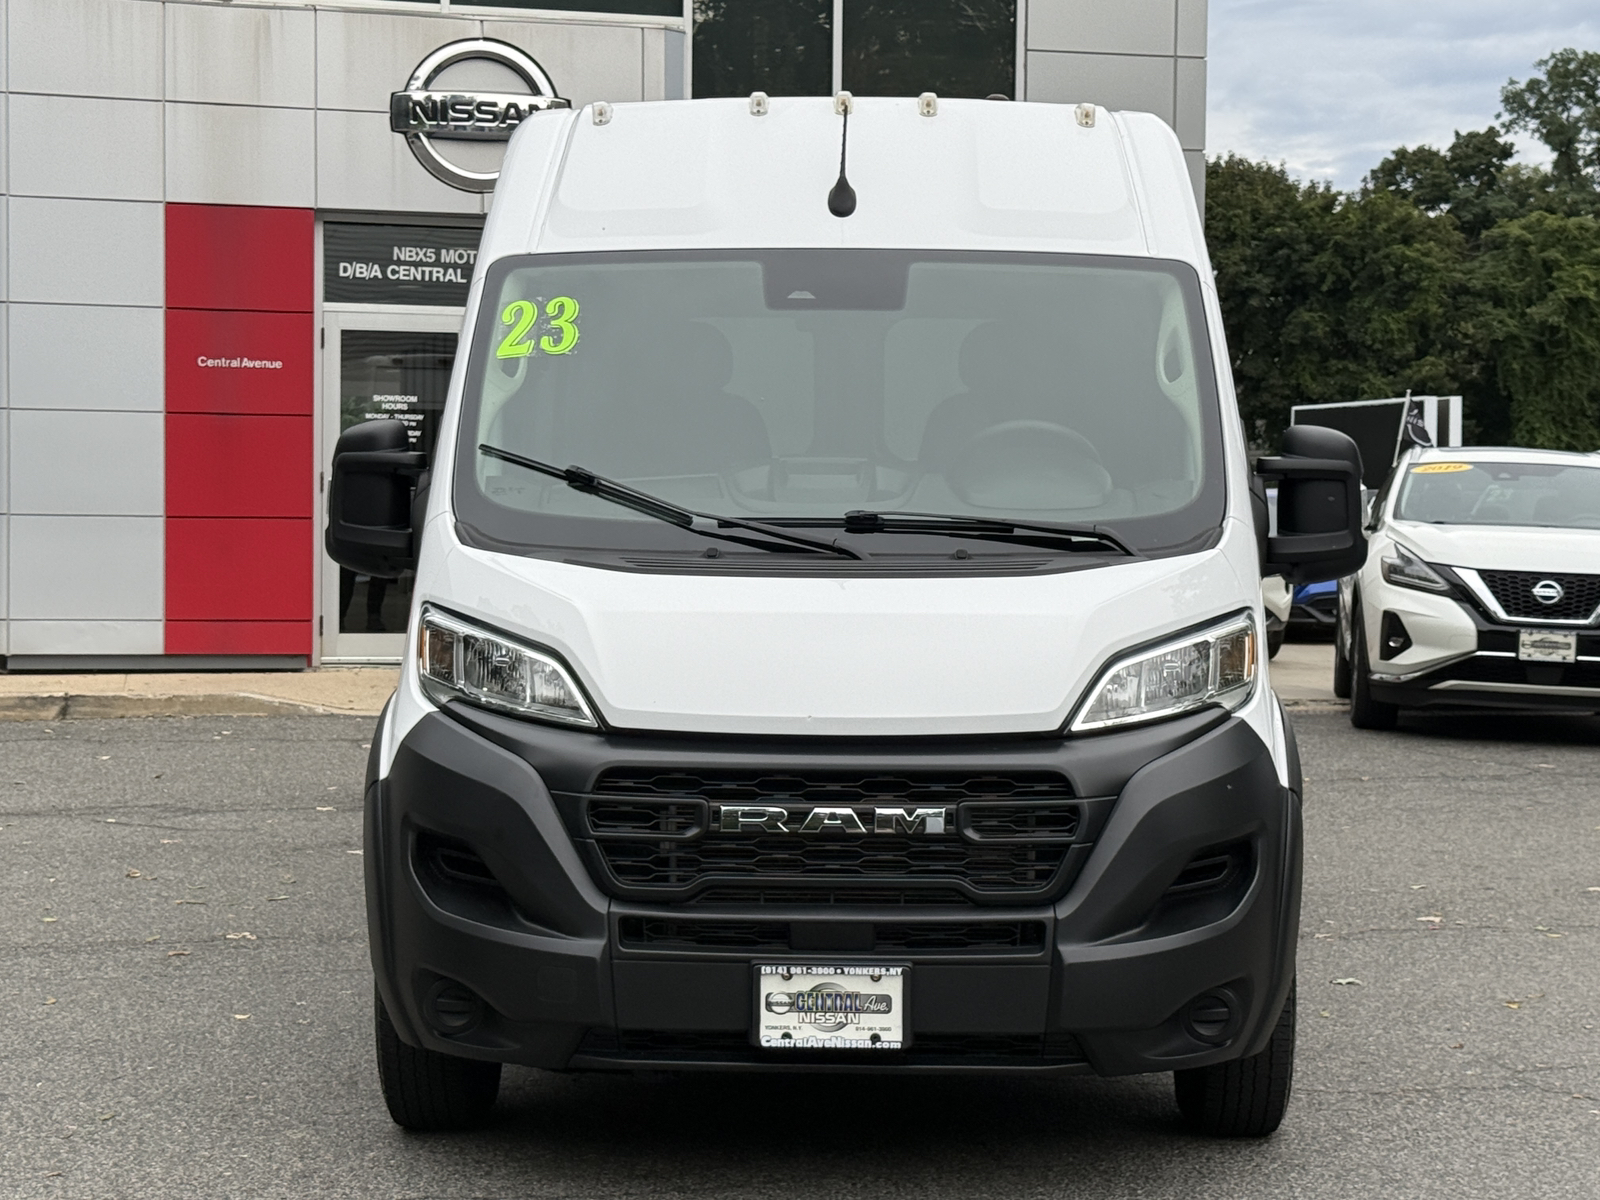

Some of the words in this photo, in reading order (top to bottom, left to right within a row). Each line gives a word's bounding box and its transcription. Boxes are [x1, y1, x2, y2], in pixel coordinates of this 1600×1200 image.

[408, 98, 544, 128] NISSA
[393, 246, 436, 262] NBX5
[441, 249, 477, 264] MOT
[339, 262, 382, 280] D/B/A
[387, 265, 467, 283] CENTRAL
[496, 296, 579, 359] 23
[197, 356, 240, 368] Central
[241, 357, 283, 369] Avenue
[373, 394, 418, 402] SHOWROOM
[720, 805, 946, 834] RAM
[795, 991, 862, 1012] CENTRAL
[863, 995, 889, 1011] Ave.
[798, 1012, 860, 1024] NISSAN
[761, 1035, 902, 1049] CentralAveNissan.com
